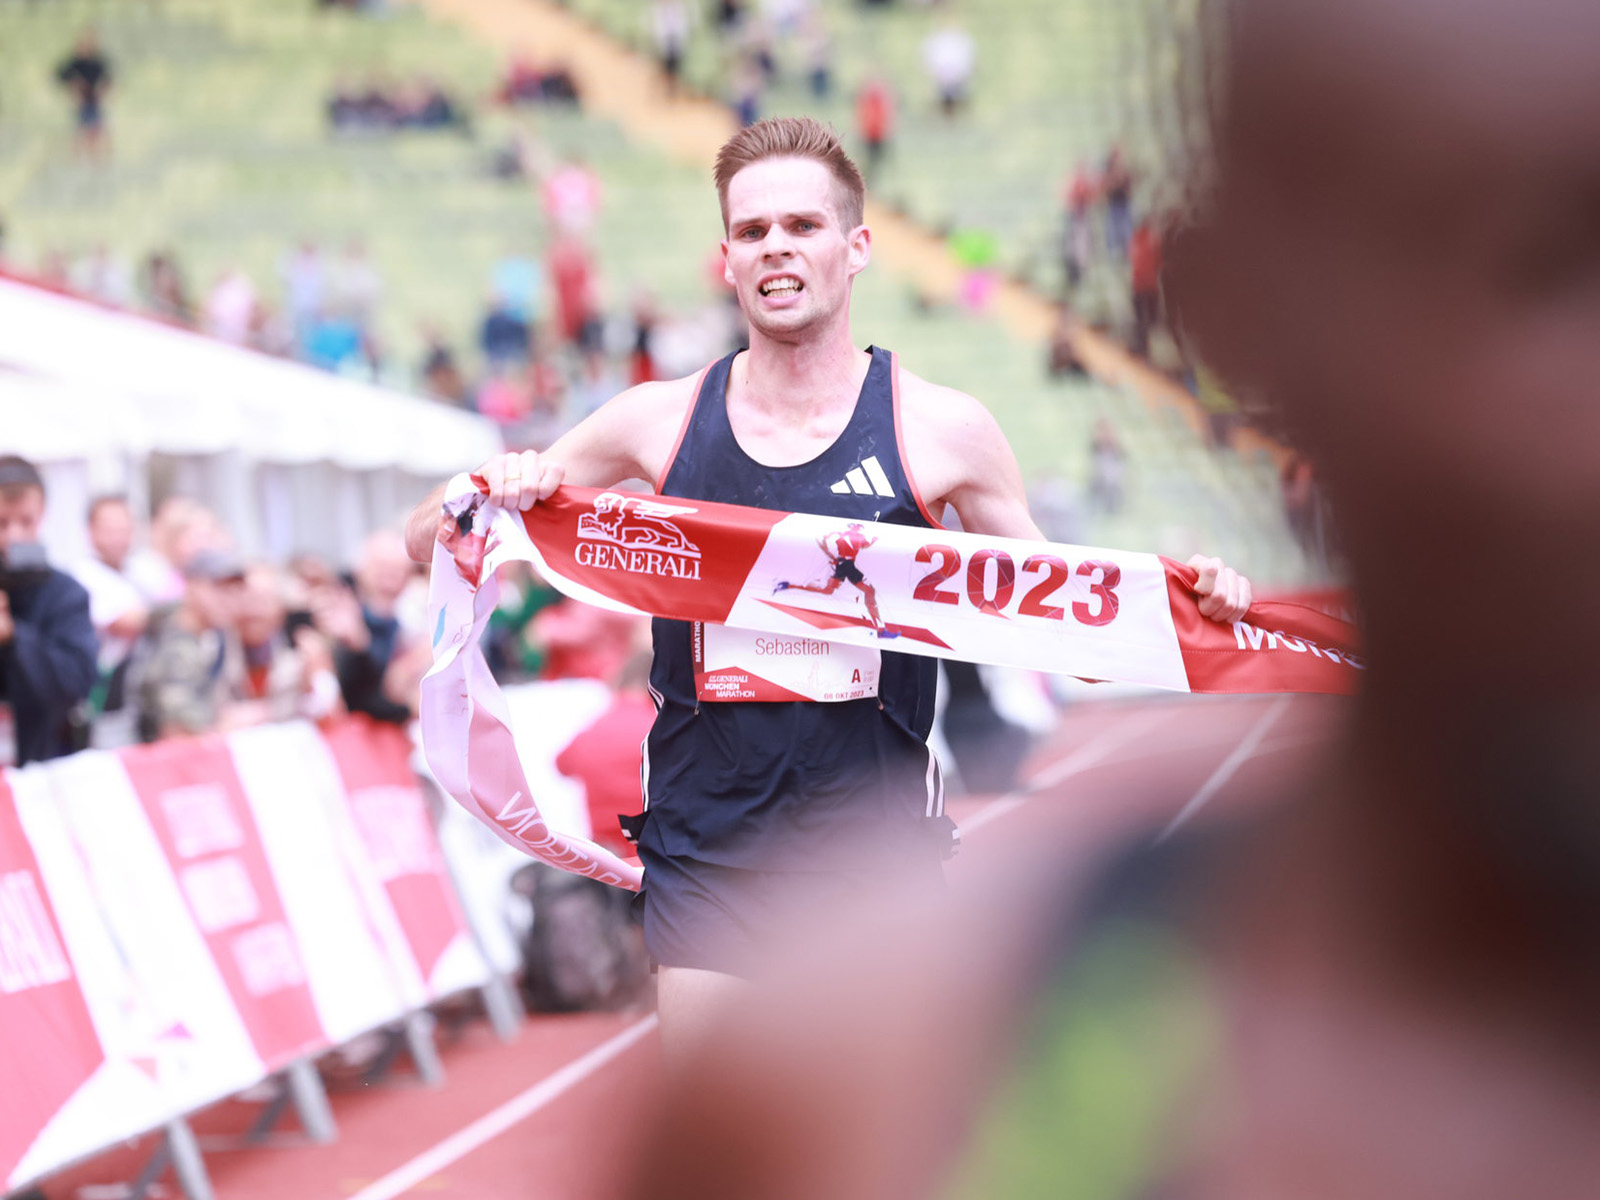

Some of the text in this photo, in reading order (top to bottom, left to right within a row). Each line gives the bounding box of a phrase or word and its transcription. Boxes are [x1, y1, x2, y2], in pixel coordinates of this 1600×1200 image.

[574, 541, 702, 581] GENERALI
[912, 543, 1122, 627] 2023
[694, 620, 702, 663] MARATHO
[755, 637, 830, 656] Sebastian
[851, 668, 861, 684] A
[716, 690, 755, 698] MARATHON
[849, 690, 864, 699] 2023
